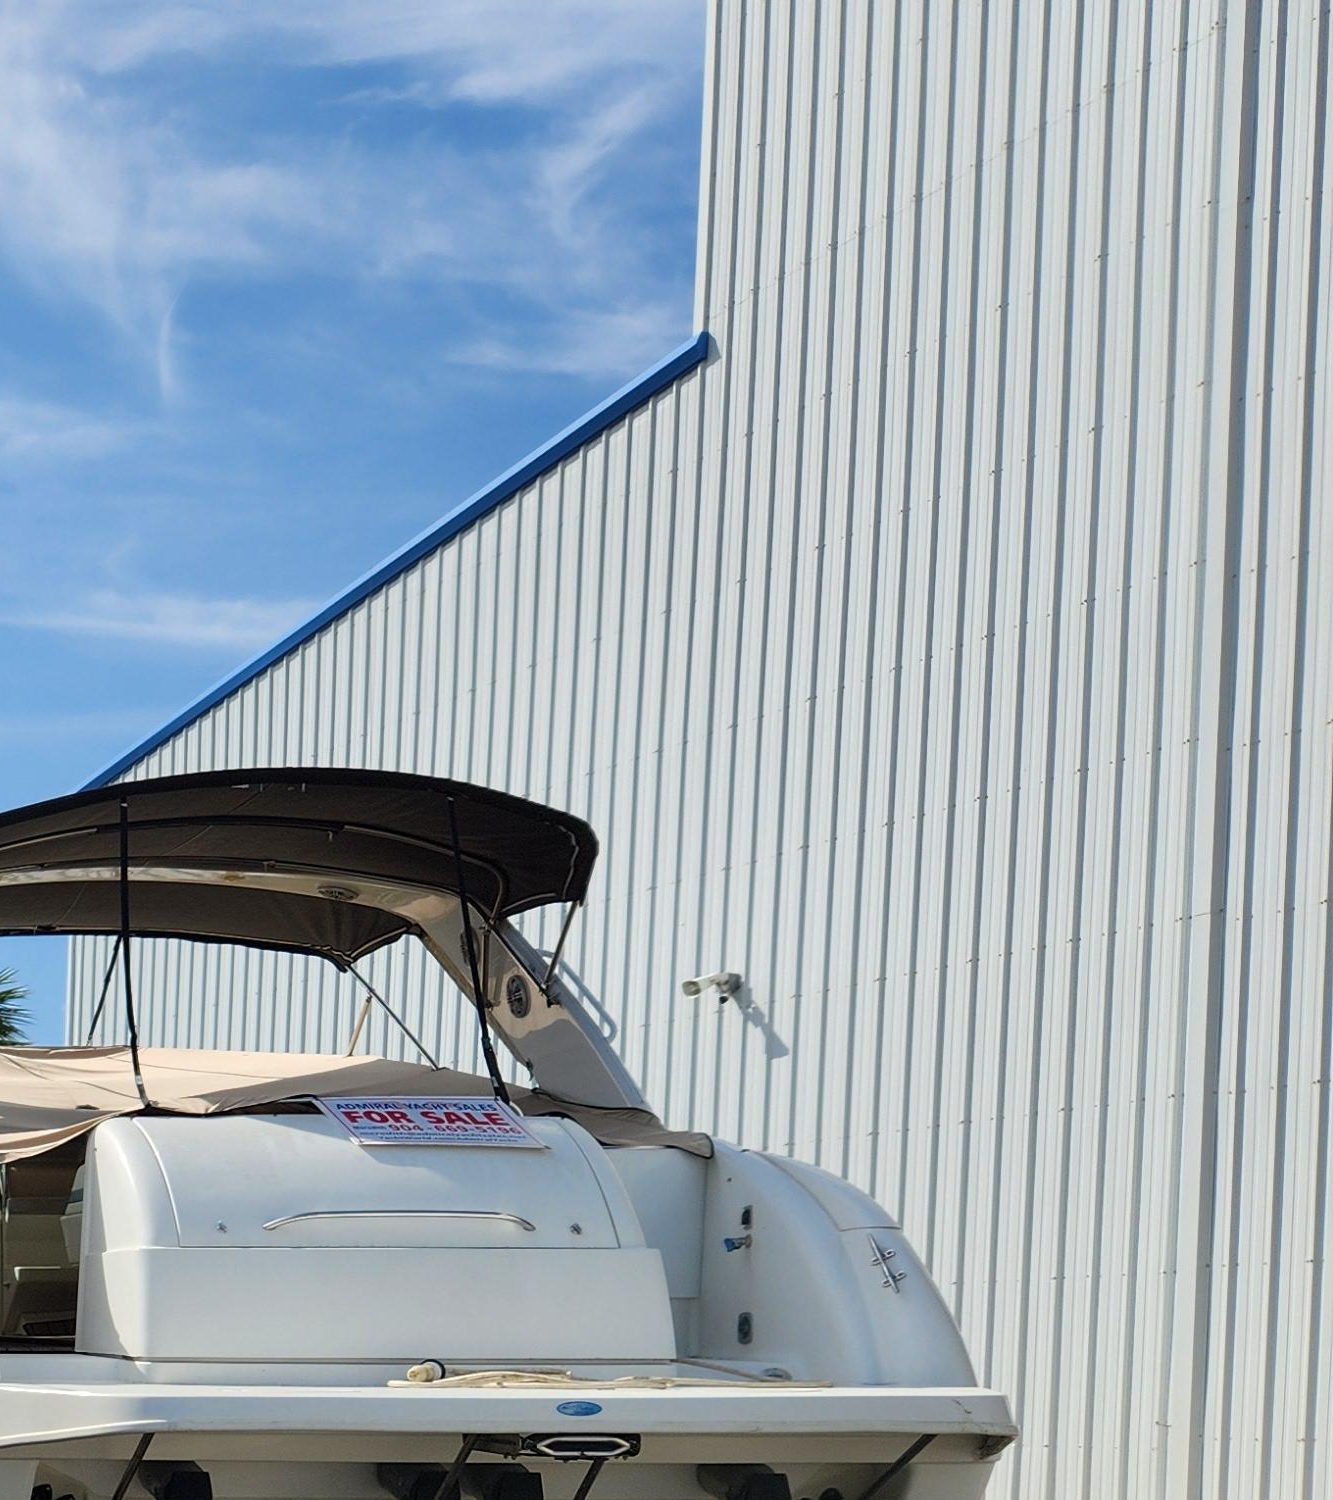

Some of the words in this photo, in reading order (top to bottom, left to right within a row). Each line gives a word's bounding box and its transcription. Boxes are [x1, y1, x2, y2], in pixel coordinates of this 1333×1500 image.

[404, 1103, 450, 1111] YACHT
[453, 1103, 498, 1112] SALES
[341, 1110, 415, 1124] FOR
[420, 1111, 510, 1126] SALE
